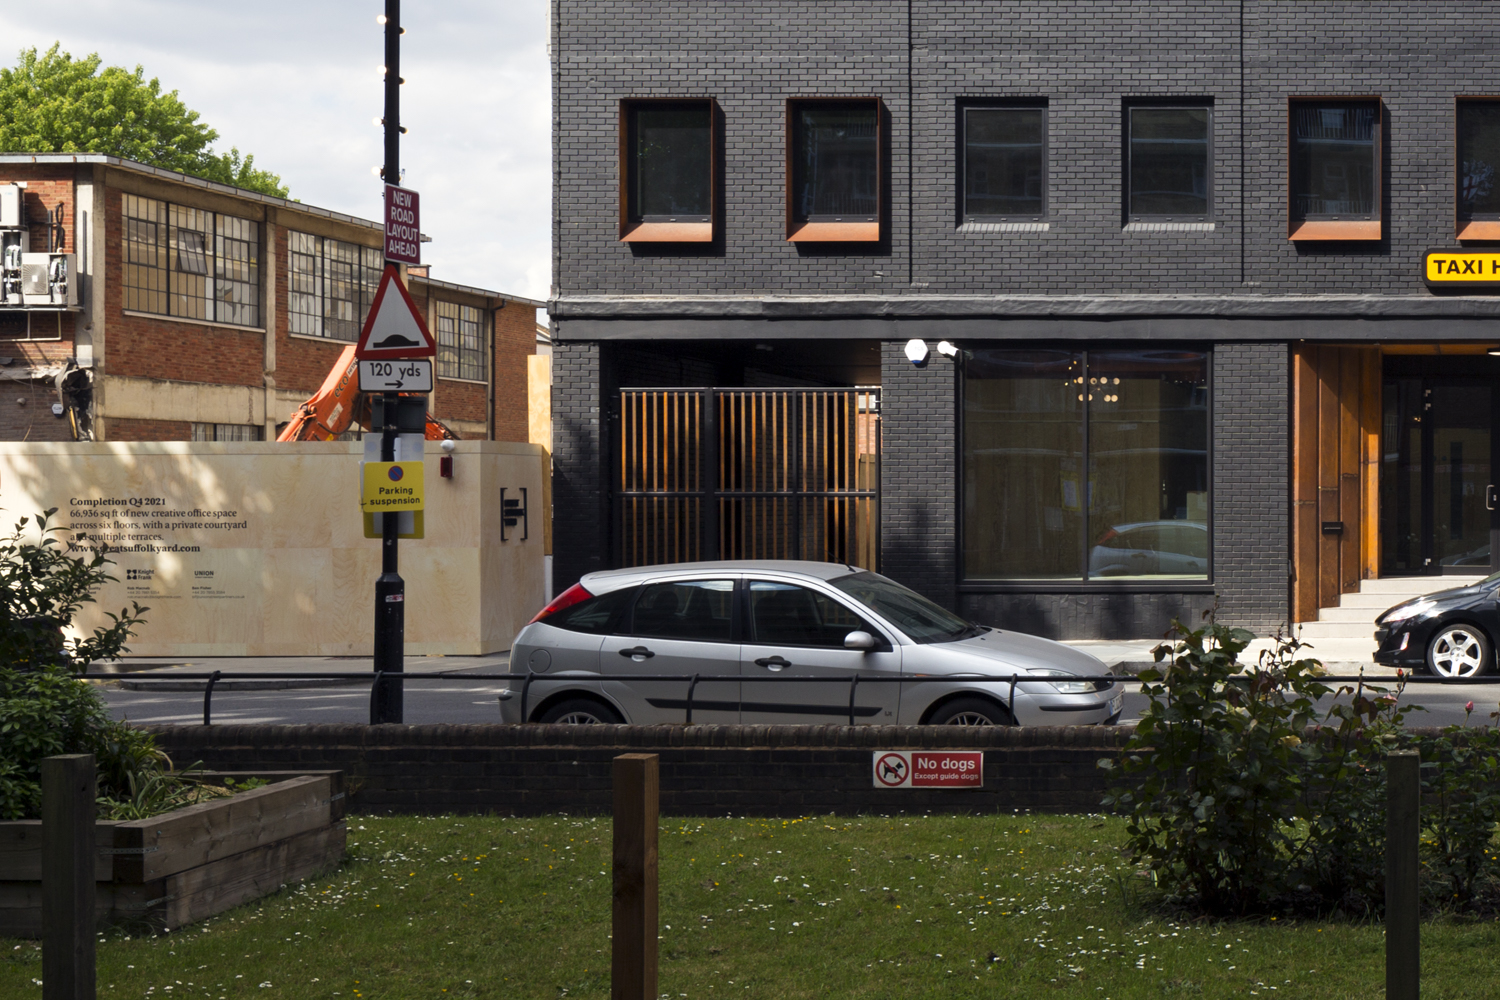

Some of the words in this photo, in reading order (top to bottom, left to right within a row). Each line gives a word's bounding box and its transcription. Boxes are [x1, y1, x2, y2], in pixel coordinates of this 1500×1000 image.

[392, 190, 412, 208] NEW
[391, 206, 415, 224] ROAD
[387, 220, 418, 241] LAYOUT
[389, 239, 417, 257] AHEAD
[1433, 260, 1483, 274] TAXI
[370, 362, 392, 377] 120
[399, 362, 421, 380] yds
[334, 375, 349, 398] eco
[378, 486, 413, 495] Parking
[70, 497, 127, 507] Completion
[129, 497, 143, 507] Q4
[144, 497, 166, 506] 2021
[369, 496, 420, 506] suspension
[70, 509, 99, 518] 66,936
[100, 511, 110, 519] sq
[112, 509, 118, 518] ft
[120, 509, 130, 518] of
[151, 509, 186, 518] creative
[187, 508, 211, 518] office
[213, 510, 237, 519] space
[99, 521, 112, 529] six
[113, 520, 141, 530] floors,
[142, 520, 163, 529] with
[171, 521, 203, 531] private
[204, 520, 247, 531] courtyard
[70, 532, 87, 541] ad
[89, 532, 126, 542] multiple
[127, 533, 165, 541] terraces.
[917, 757, 937, 769] No
[941, 757, 975, 772] dogs
[914, 772, 938, 781] Except
[940, 772, 959, 781] guide
[960, 772, 979, 781] dogs
